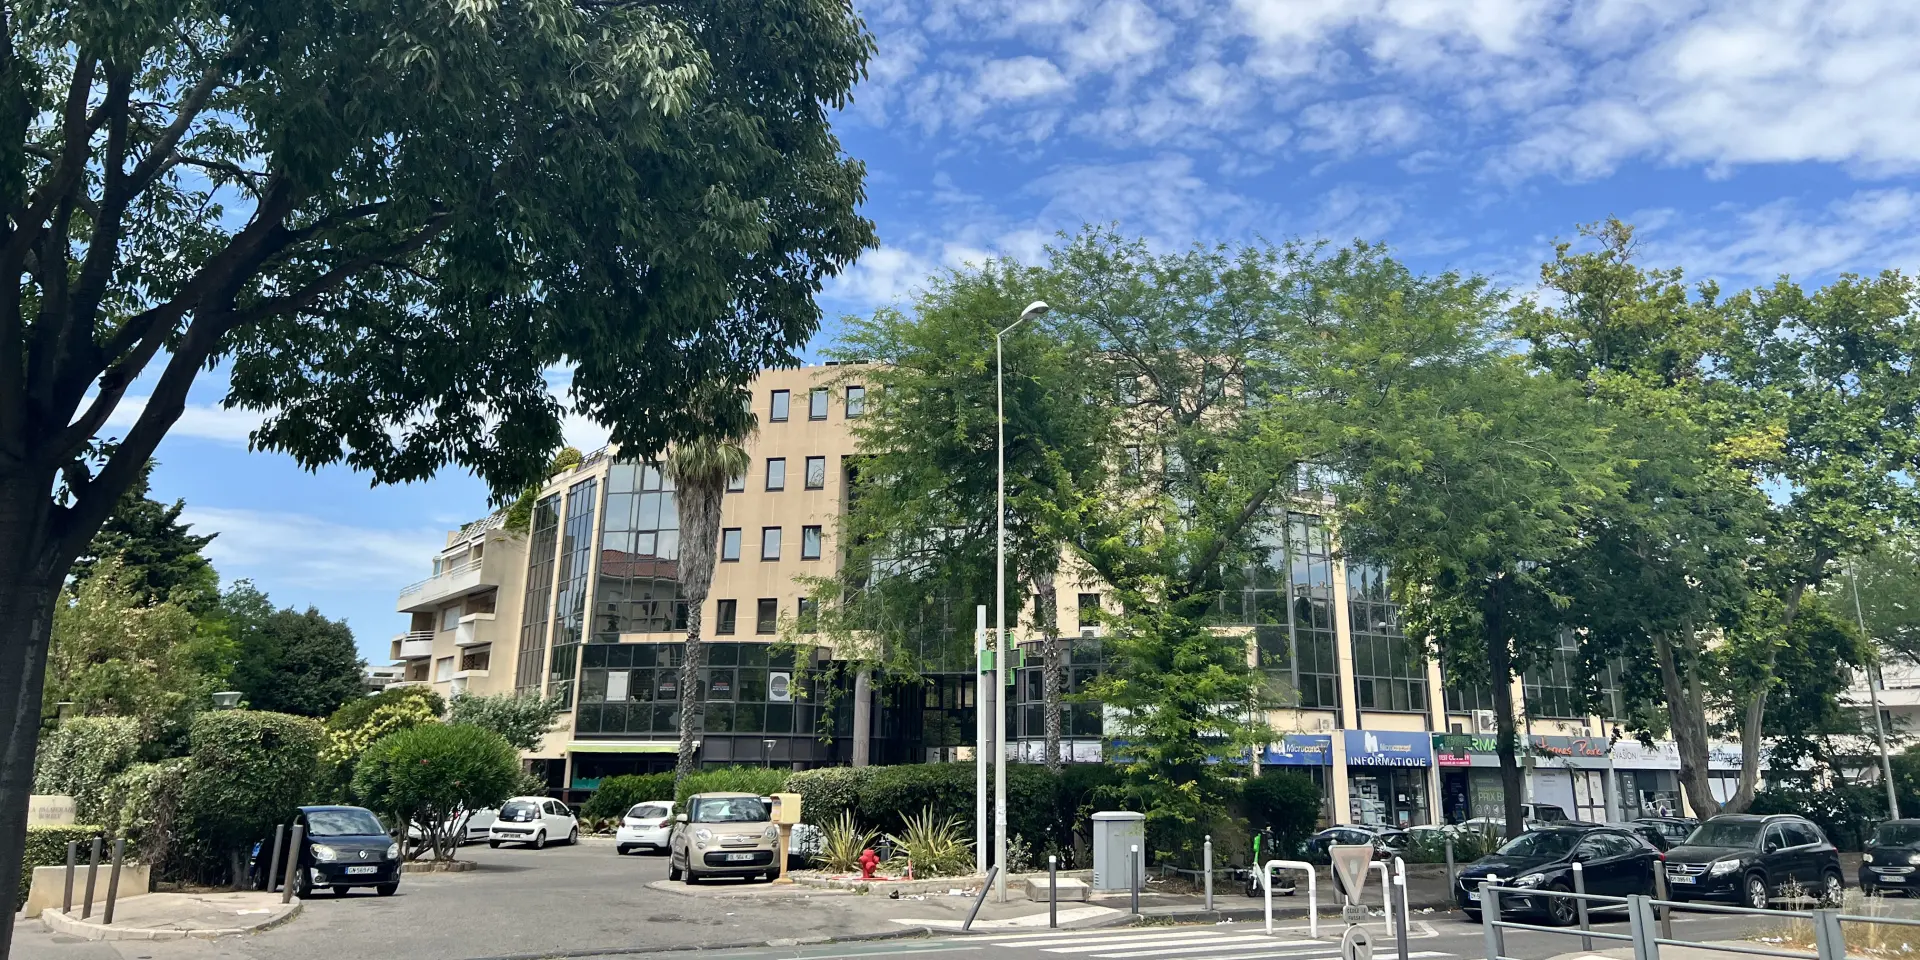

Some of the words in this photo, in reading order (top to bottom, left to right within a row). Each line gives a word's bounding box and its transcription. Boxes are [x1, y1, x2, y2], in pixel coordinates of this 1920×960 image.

[1573, 740, 1603, 755] Park
[1350, 756, 1427, 767] INFORMATIQUE
[1478, 791, 1496, 802] PRIX
